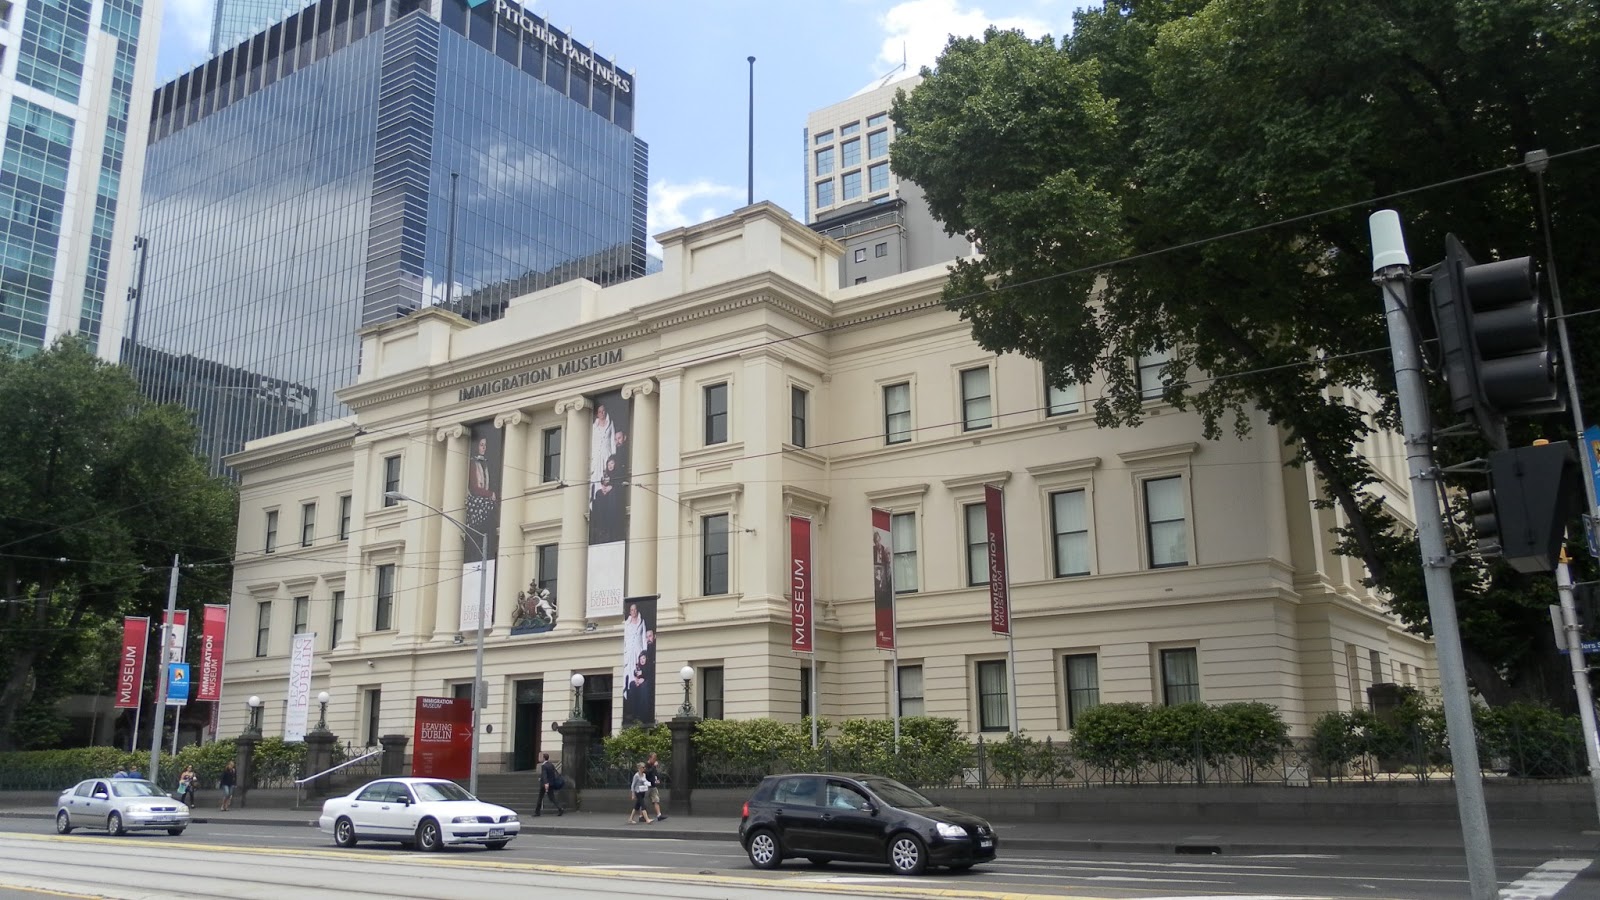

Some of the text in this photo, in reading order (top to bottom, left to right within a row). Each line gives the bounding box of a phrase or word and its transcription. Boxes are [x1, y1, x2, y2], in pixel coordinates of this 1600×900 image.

[494, 0, 630, 93] PITCHER PARTNERS
[458, 348, 623, 402] IMMIGRATION MUSEUM
[590, 596, 621, 607] DUBLIN
[591, 588, 621, 597] LEAVING
[794, 559, 805, 645] MUSEUM
[990, 532, 1000, 625] IMMIGRATION
[996, 570, 1005, 626] MUSEUM
[463, 611, 490, 620] DUBN
[120, 646, 137, 703] MUSEUM
[201, 635, 214, 695] IMMIGRATION
[208, 659, 218, 696] MUSEUM
[289, 638, 304, 708] LEAVING
[297, 639, 312, 708] DUBLIN
[421, 722, 452, 731] LEAVING
[421, 730, 452, 739] DUBLIN
